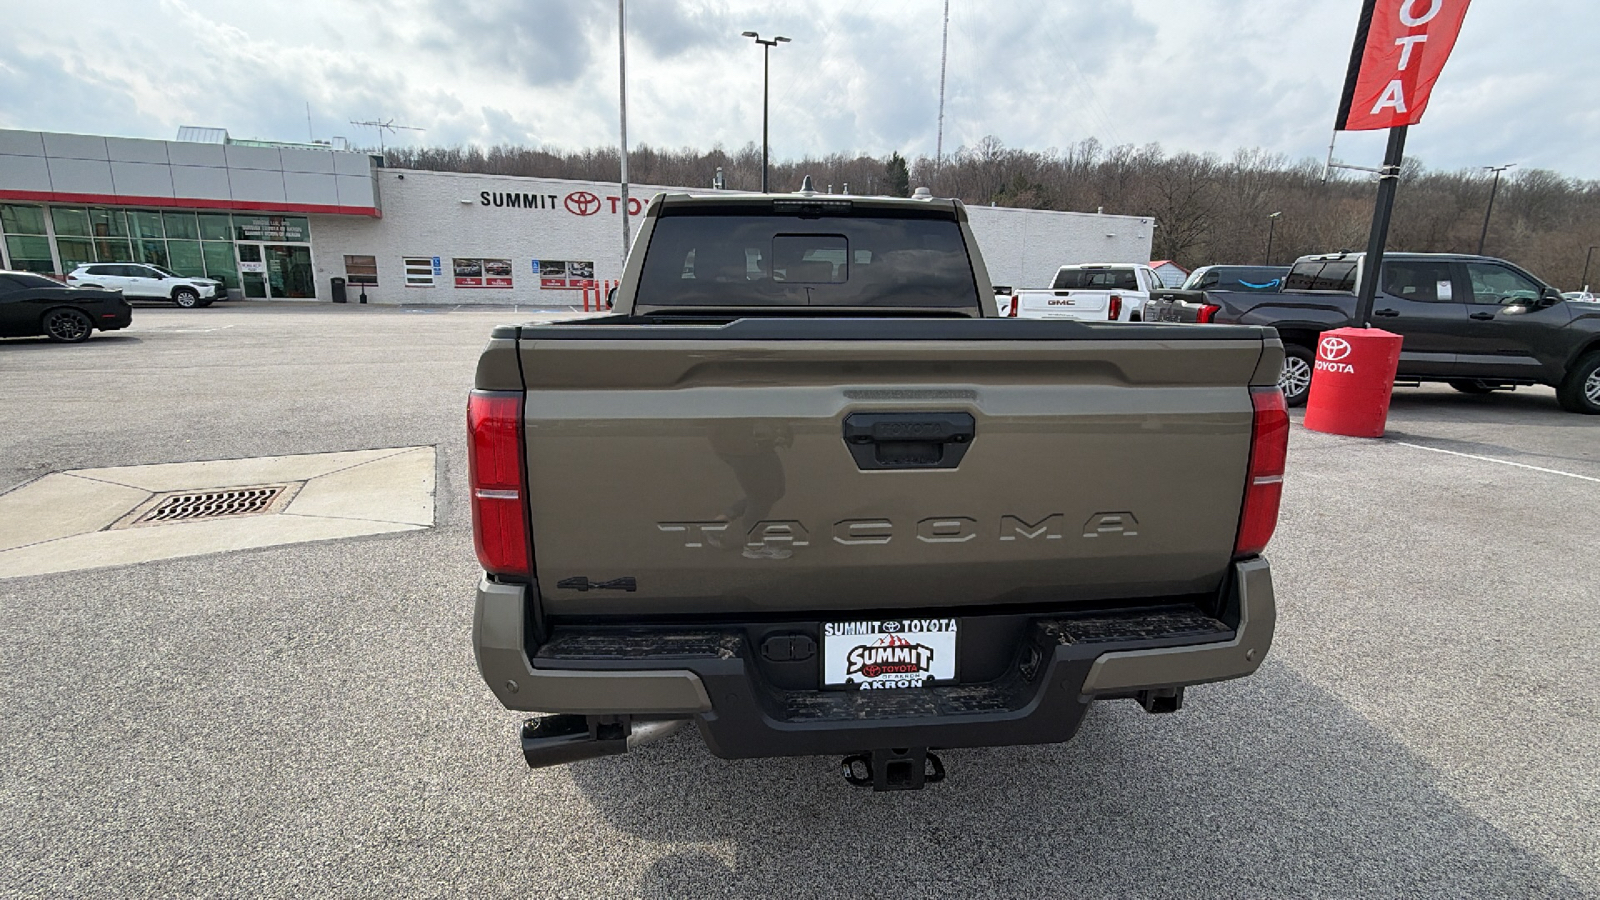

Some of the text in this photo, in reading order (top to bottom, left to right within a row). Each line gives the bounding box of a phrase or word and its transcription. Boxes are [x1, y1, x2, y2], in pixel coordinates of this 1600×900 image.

[480, 191, 650, 216] SUMMIT TO
[657, 511, 1138, 548] TACOMA
[825, 619, 957, 635] SUMMIT TOYOTA
[849, 647, 931, 672] SUMMIT
[882, 664, 917, 672] TOYOTA
[860, 679, 922, 690] AKRON
